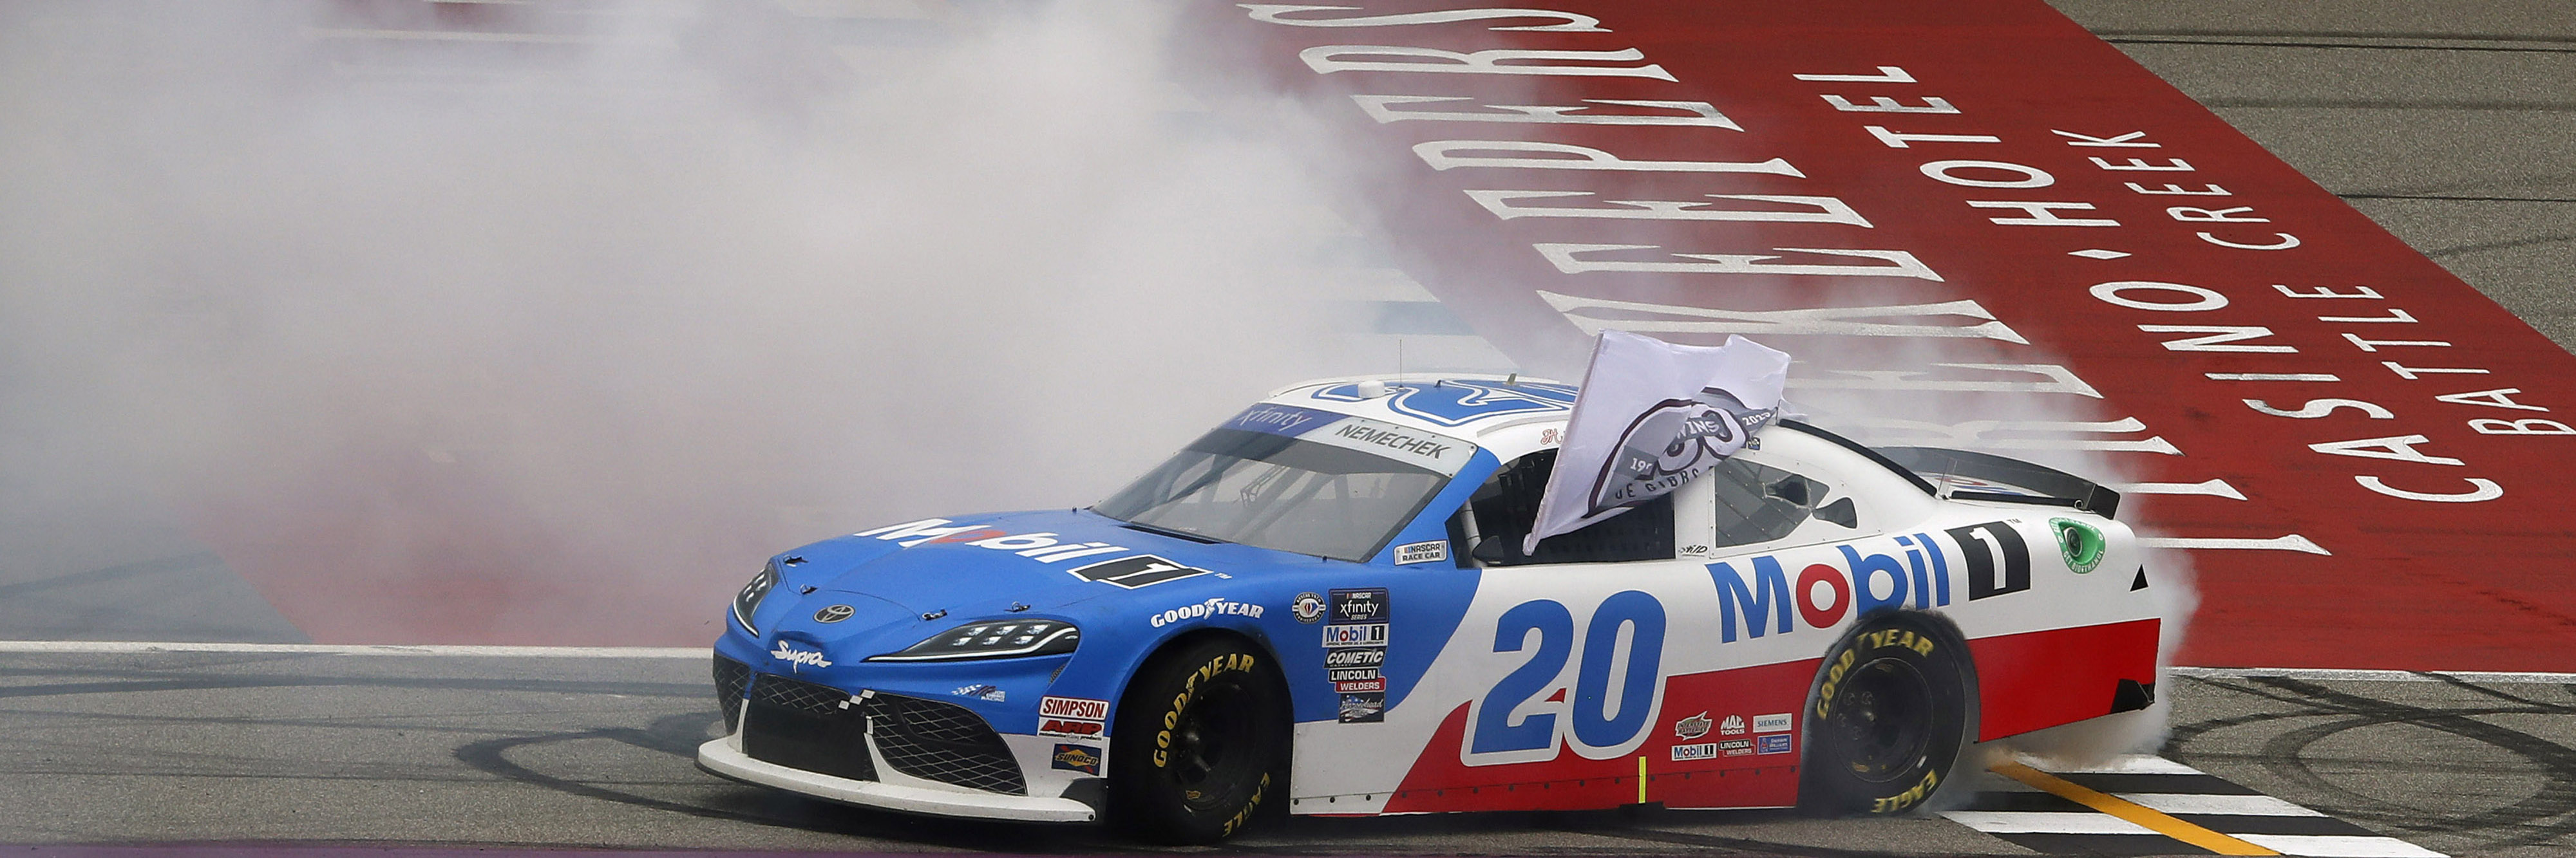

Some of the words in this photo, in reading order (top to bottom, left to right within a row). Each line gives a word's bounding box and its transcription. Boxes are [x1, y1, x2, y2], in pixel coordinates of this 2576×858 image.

[1792, 65, 2121, 227] HOTEL
[2050, 129, 2301, 250] CREEK
[2272, 284, 2576, 435] BATTLE
[2088, 281, 2504, 503] CASINO
[1238, 408, 1312, 431] xfinity
[1334, 423, 1452, 460] NEMECHEK
[854, 517, 1130, 564] Mobil
[1410, 543, 1441, 554] NASCAR
[1402, 554, 1423, 562] RACE
[1704, 532, 1951, 644] Mobil
[1150, 597, 1264, 628] GOODYEAR
[1340, 599, 1379, 617] xfinity
[1327, 626, 1367, 642] Mobil
[770, 640, 832, 674] Supra
[1327, 651, 1384, 665] COMETIC
[1331, 669, 1376, 681] LINCOLN
[1468, 588, 1669, 760] 20
[1340, 682, 1380, 691] WELDERS
[1043, 698, 1104, 718] SIMPSON
[1153, 653, 1255, 768] GOODYEAR
[1040, 720, 1103, 736] ARP
[1720, 714, 1745, 730] MAC
[1757, 719, 1787, 727] SIEMENS
[1674, 745, 1702, 758] Mobil
[1719, 740, 1750, 749] LINCOLN
[1056, 754, 1097, 765] SUNOCO
